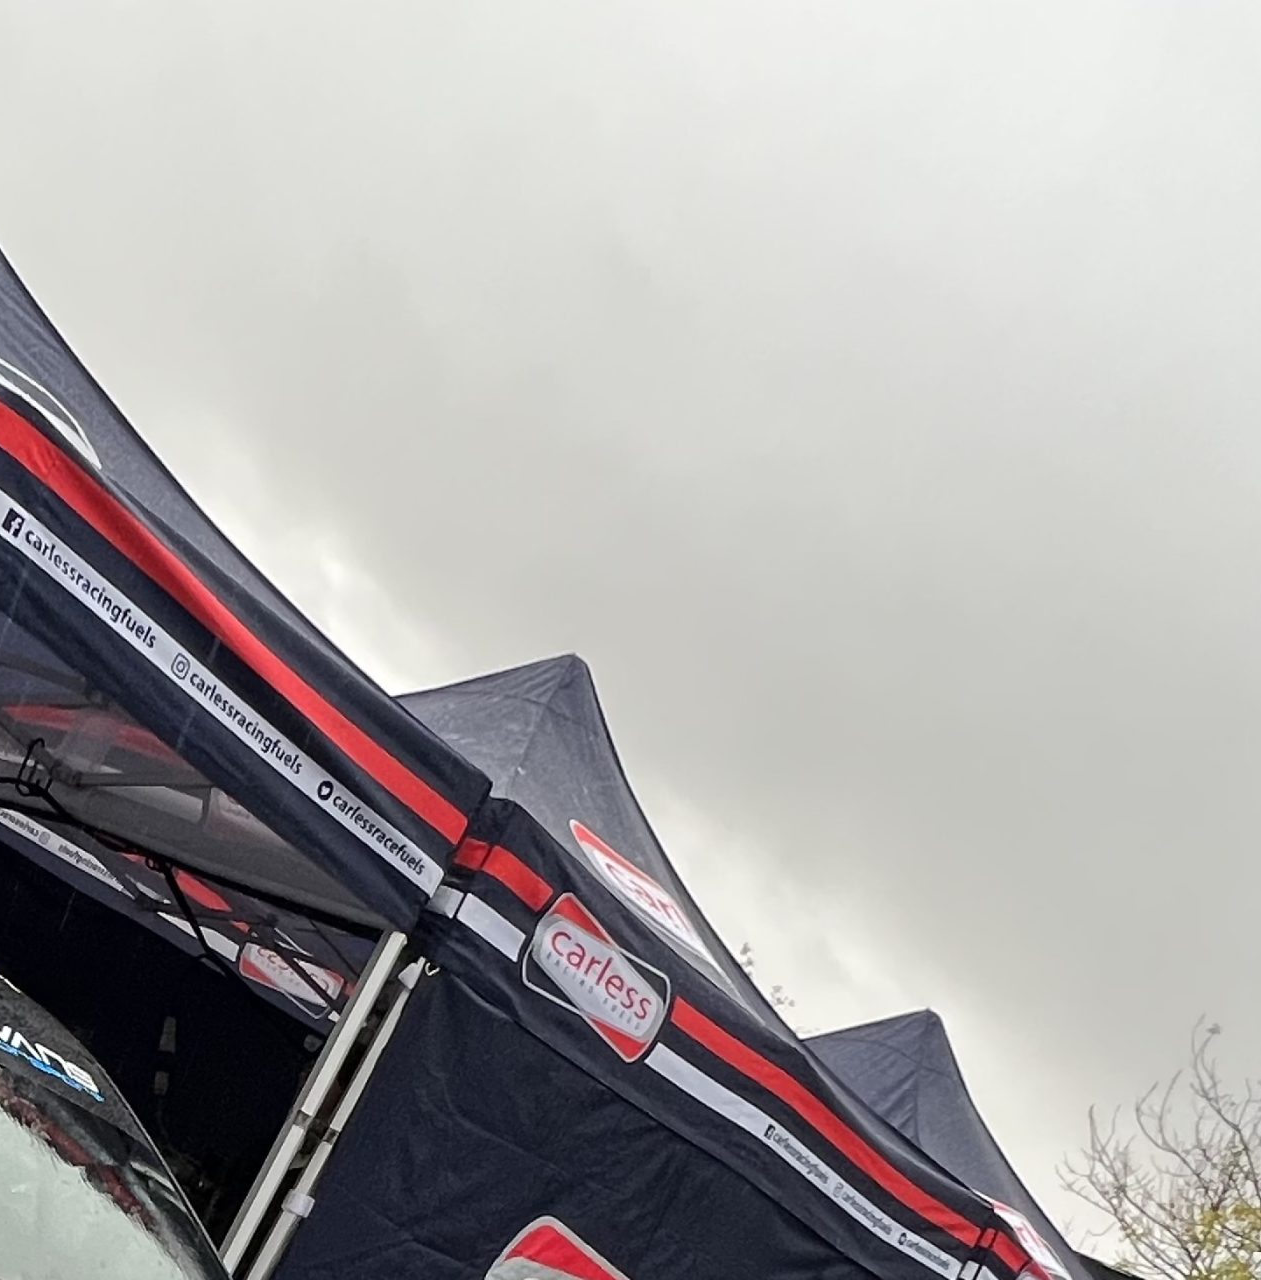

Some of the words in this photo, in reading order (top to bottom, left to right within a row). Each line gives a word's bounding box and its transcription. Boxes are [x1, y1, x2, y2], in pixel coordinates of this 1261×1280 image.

[24, 527, 157, 650] carlessracingfuels
[189, 670, 304, 776] carlessracingfuels
[332, 793, 426, 877] carlessracefuels
[551, 931, 652, 1020] carless
